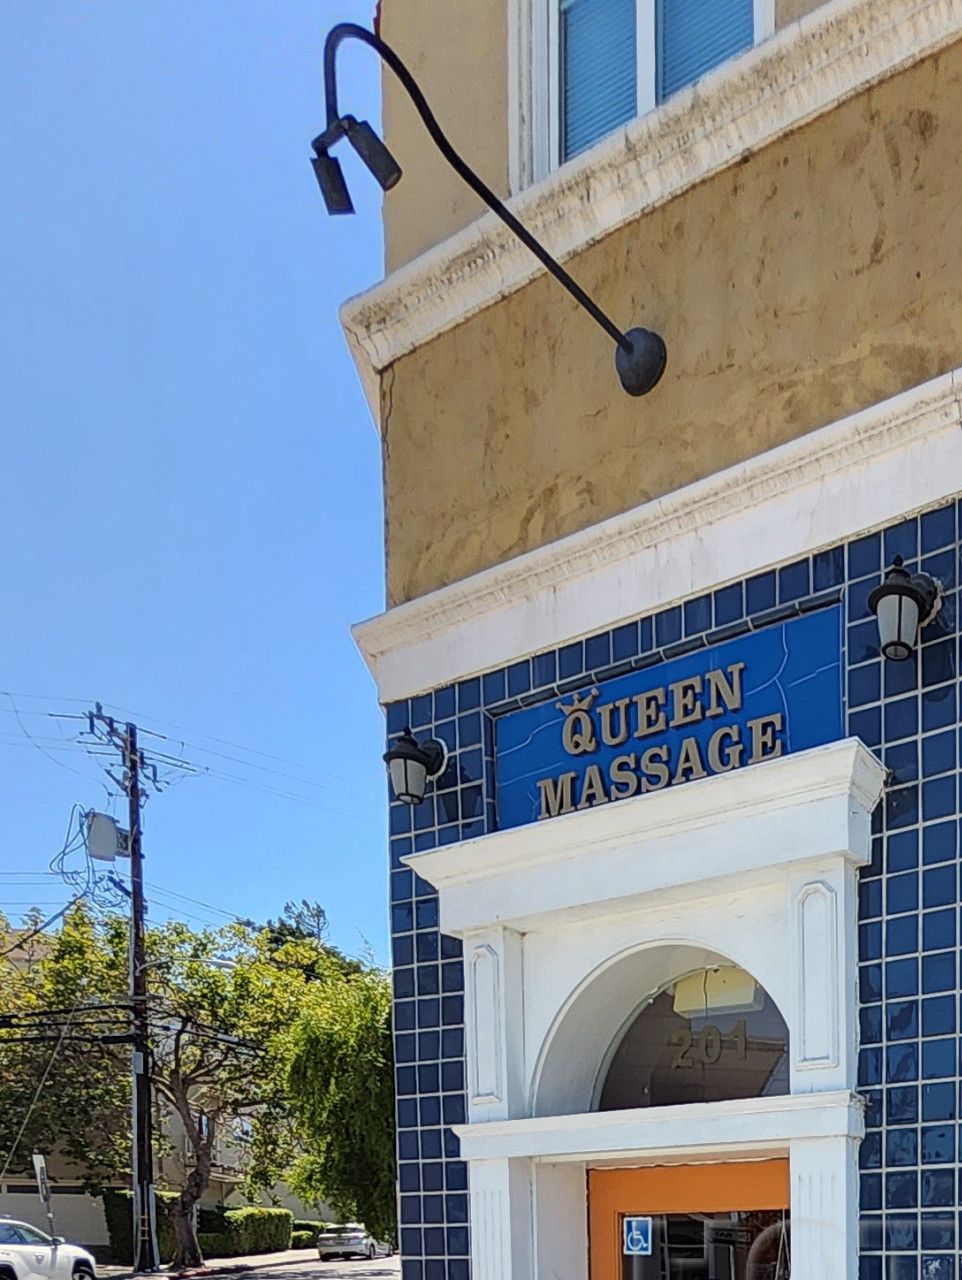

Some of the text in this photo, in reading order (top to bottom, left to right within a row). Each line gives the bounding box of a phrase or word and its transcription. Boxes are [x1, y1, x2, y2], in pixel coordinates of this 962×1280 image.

[561, 661, 746, 755] QUEEN
[537, 712, 784, 820] MASSAGE
[671, 1019, 748, 1069] 201
